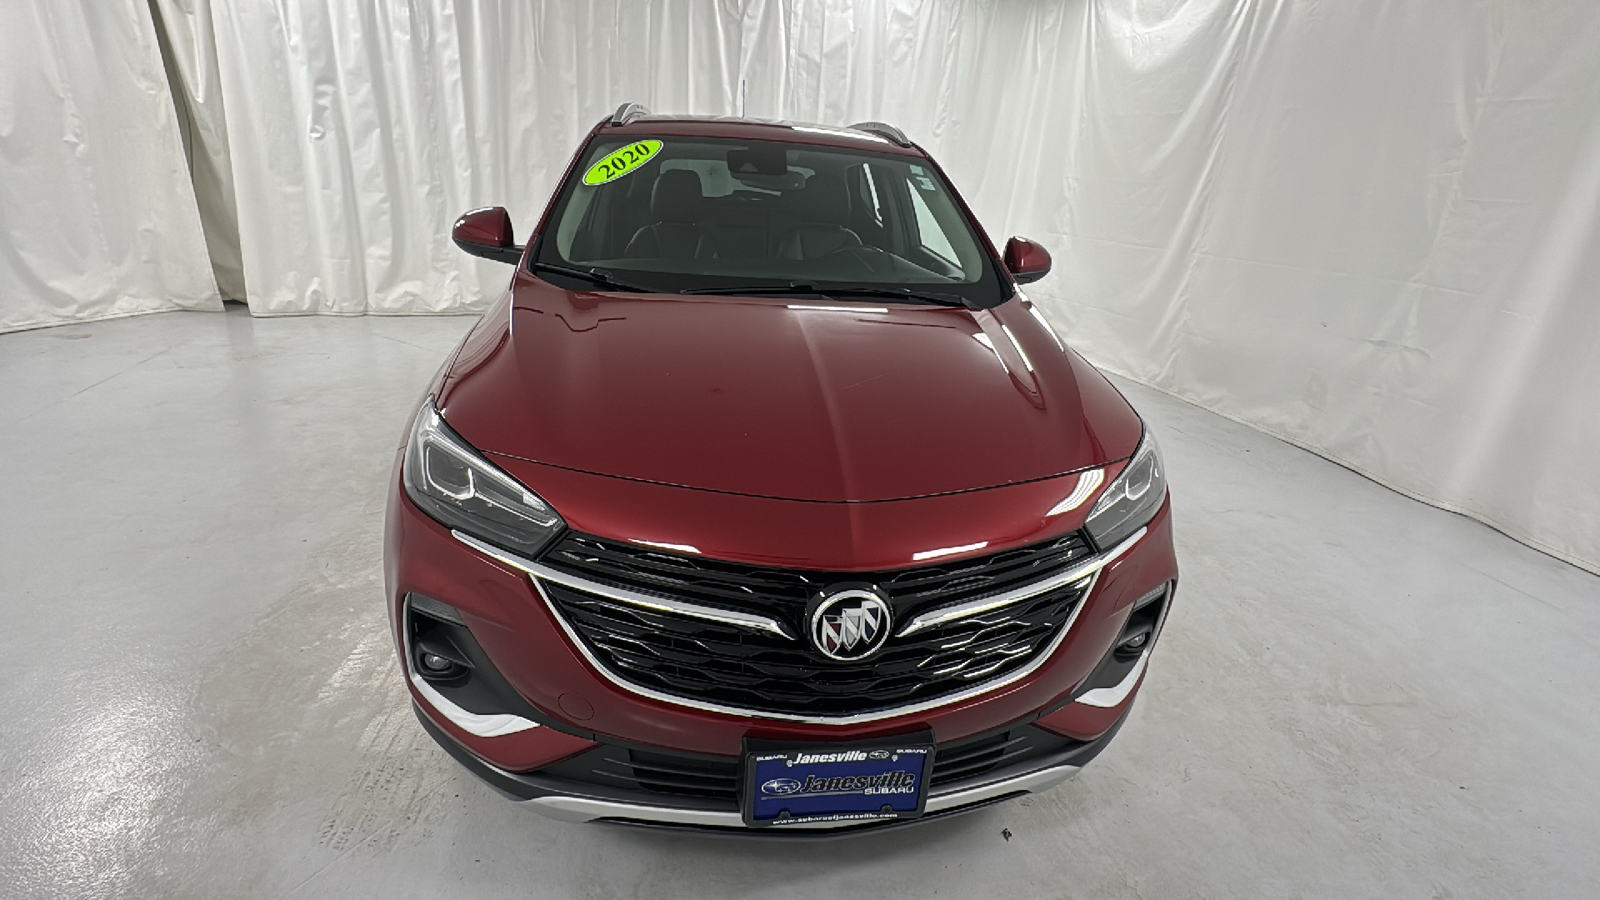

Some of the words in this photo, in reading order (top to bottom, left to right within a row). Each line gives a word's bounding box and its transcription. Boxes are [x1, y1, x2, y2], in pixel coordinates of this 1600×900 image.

[598, 143, 650, 179] 2020
[793, 750, 868, 764] Janesville
[800, 770, 915, 793] Janesville
[864, 787, 914, 795] SUBARU
